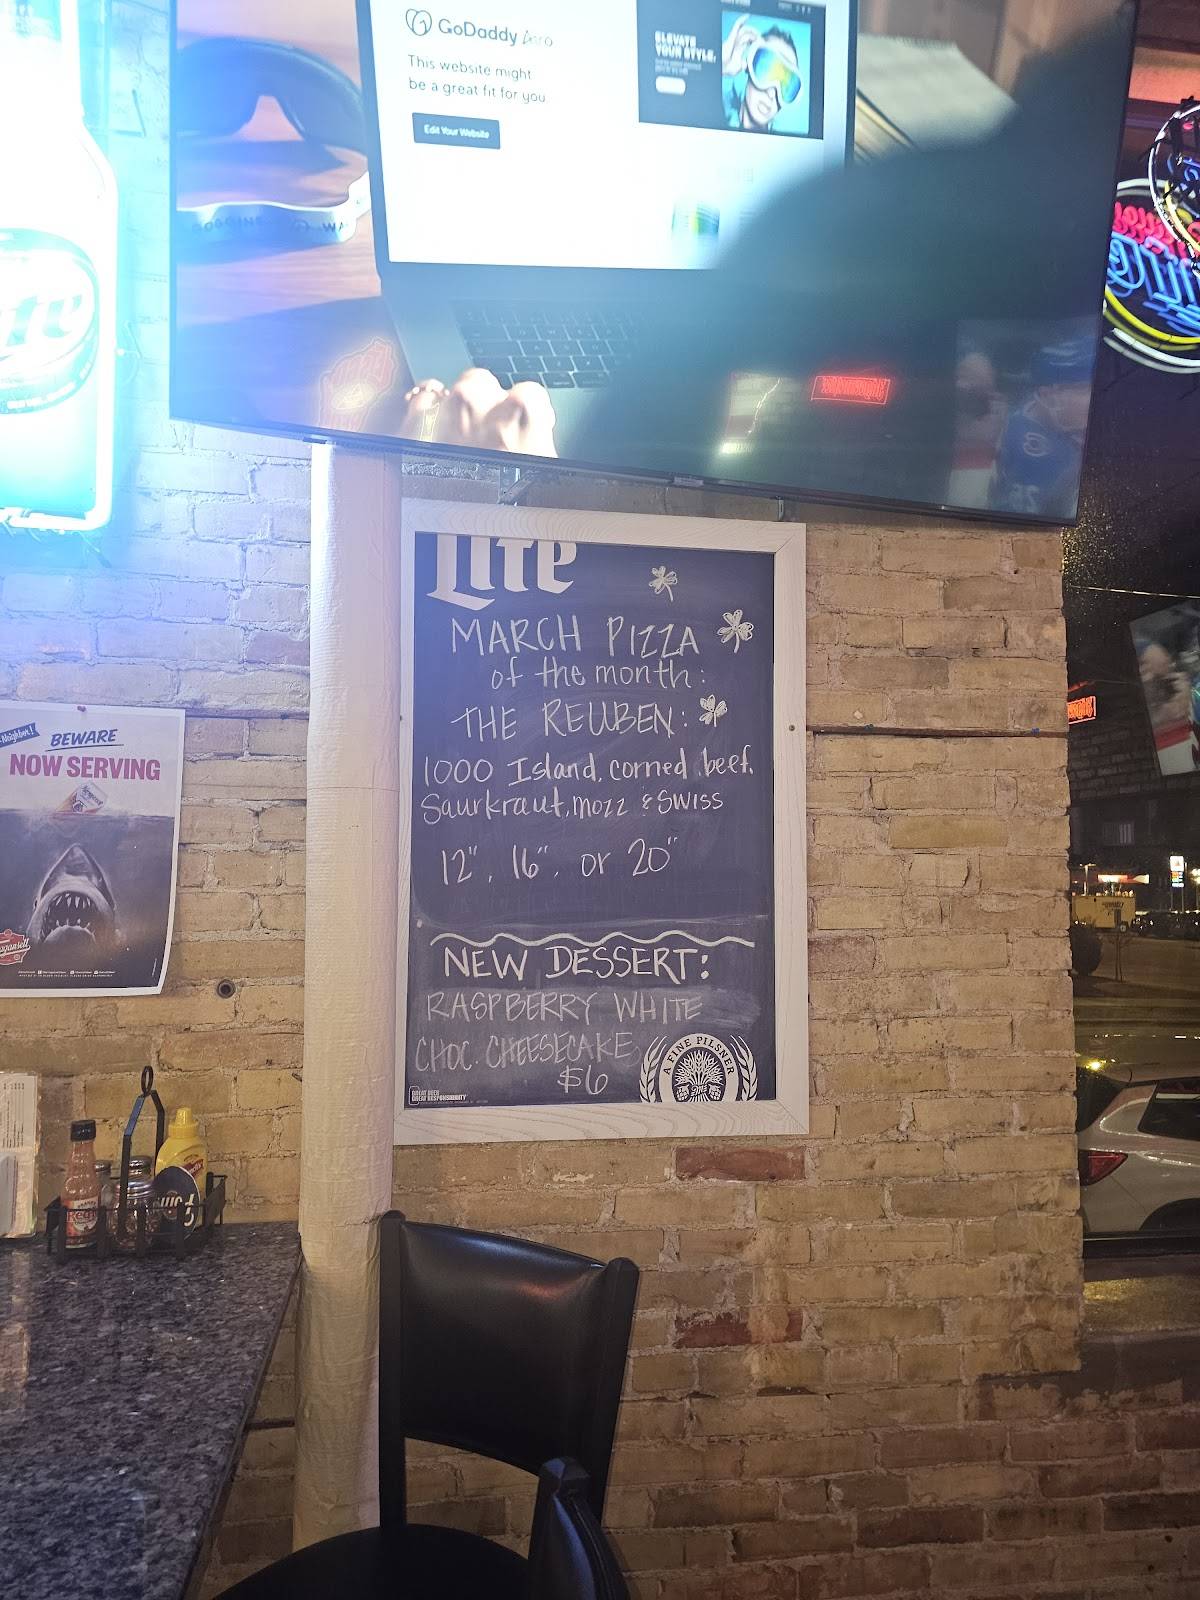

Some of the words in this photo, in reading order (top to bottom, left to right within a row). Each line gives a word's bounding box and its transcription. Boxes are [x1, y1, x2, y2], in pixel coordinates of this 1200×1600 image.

[438, 18, 518, 47] GoDaddy
[408, 54, 435, 70] This
[440, 61, 491, 76] website
[496, 68, 531, 82] might
[409, 77, 426, 91] be
[431, 82, 438, 92] a
[443, 83, 478, 96] great
[483, 84, 496, 98] fit
[501, 87, 518, 100] for
[522, 92, 546, 104] you
[423, 124, 440, 136] Edit
[441, 126, 459, 137] Your
[460, 127, 490, 140] Website
[427, 534, 577, 610] Lite
[452, 614, 581, 656] MARCH
[607, 616, 700, 659] PIZZA
[491, 656, 523, 689] of
[535, 656, 586, 689] the
[51, 728, 118, 747] BEWARE
[450, 706, 517, 741] THE
[9, 753, 63, 777] NOW
[66, 755, 161, 781] SERVING
[424, 756, 494, 787] 1000
[609, 747, 688, 781] corned
[581, 852, 611, 877] or
[444, 946, 528, 981] NEW
[426, 991, 598, 1026] RASPBERRY
[613, 991, 704, 1025] WHITE
[486, 1030, 634, 1070] CHEESECAKE
[666, 1038, 692, 1064] FINE
[696, 1036, 735, 1075] PILSNER
[557, 1064, 609, 1096] $6
[663, 1066, 672, 1076] A
